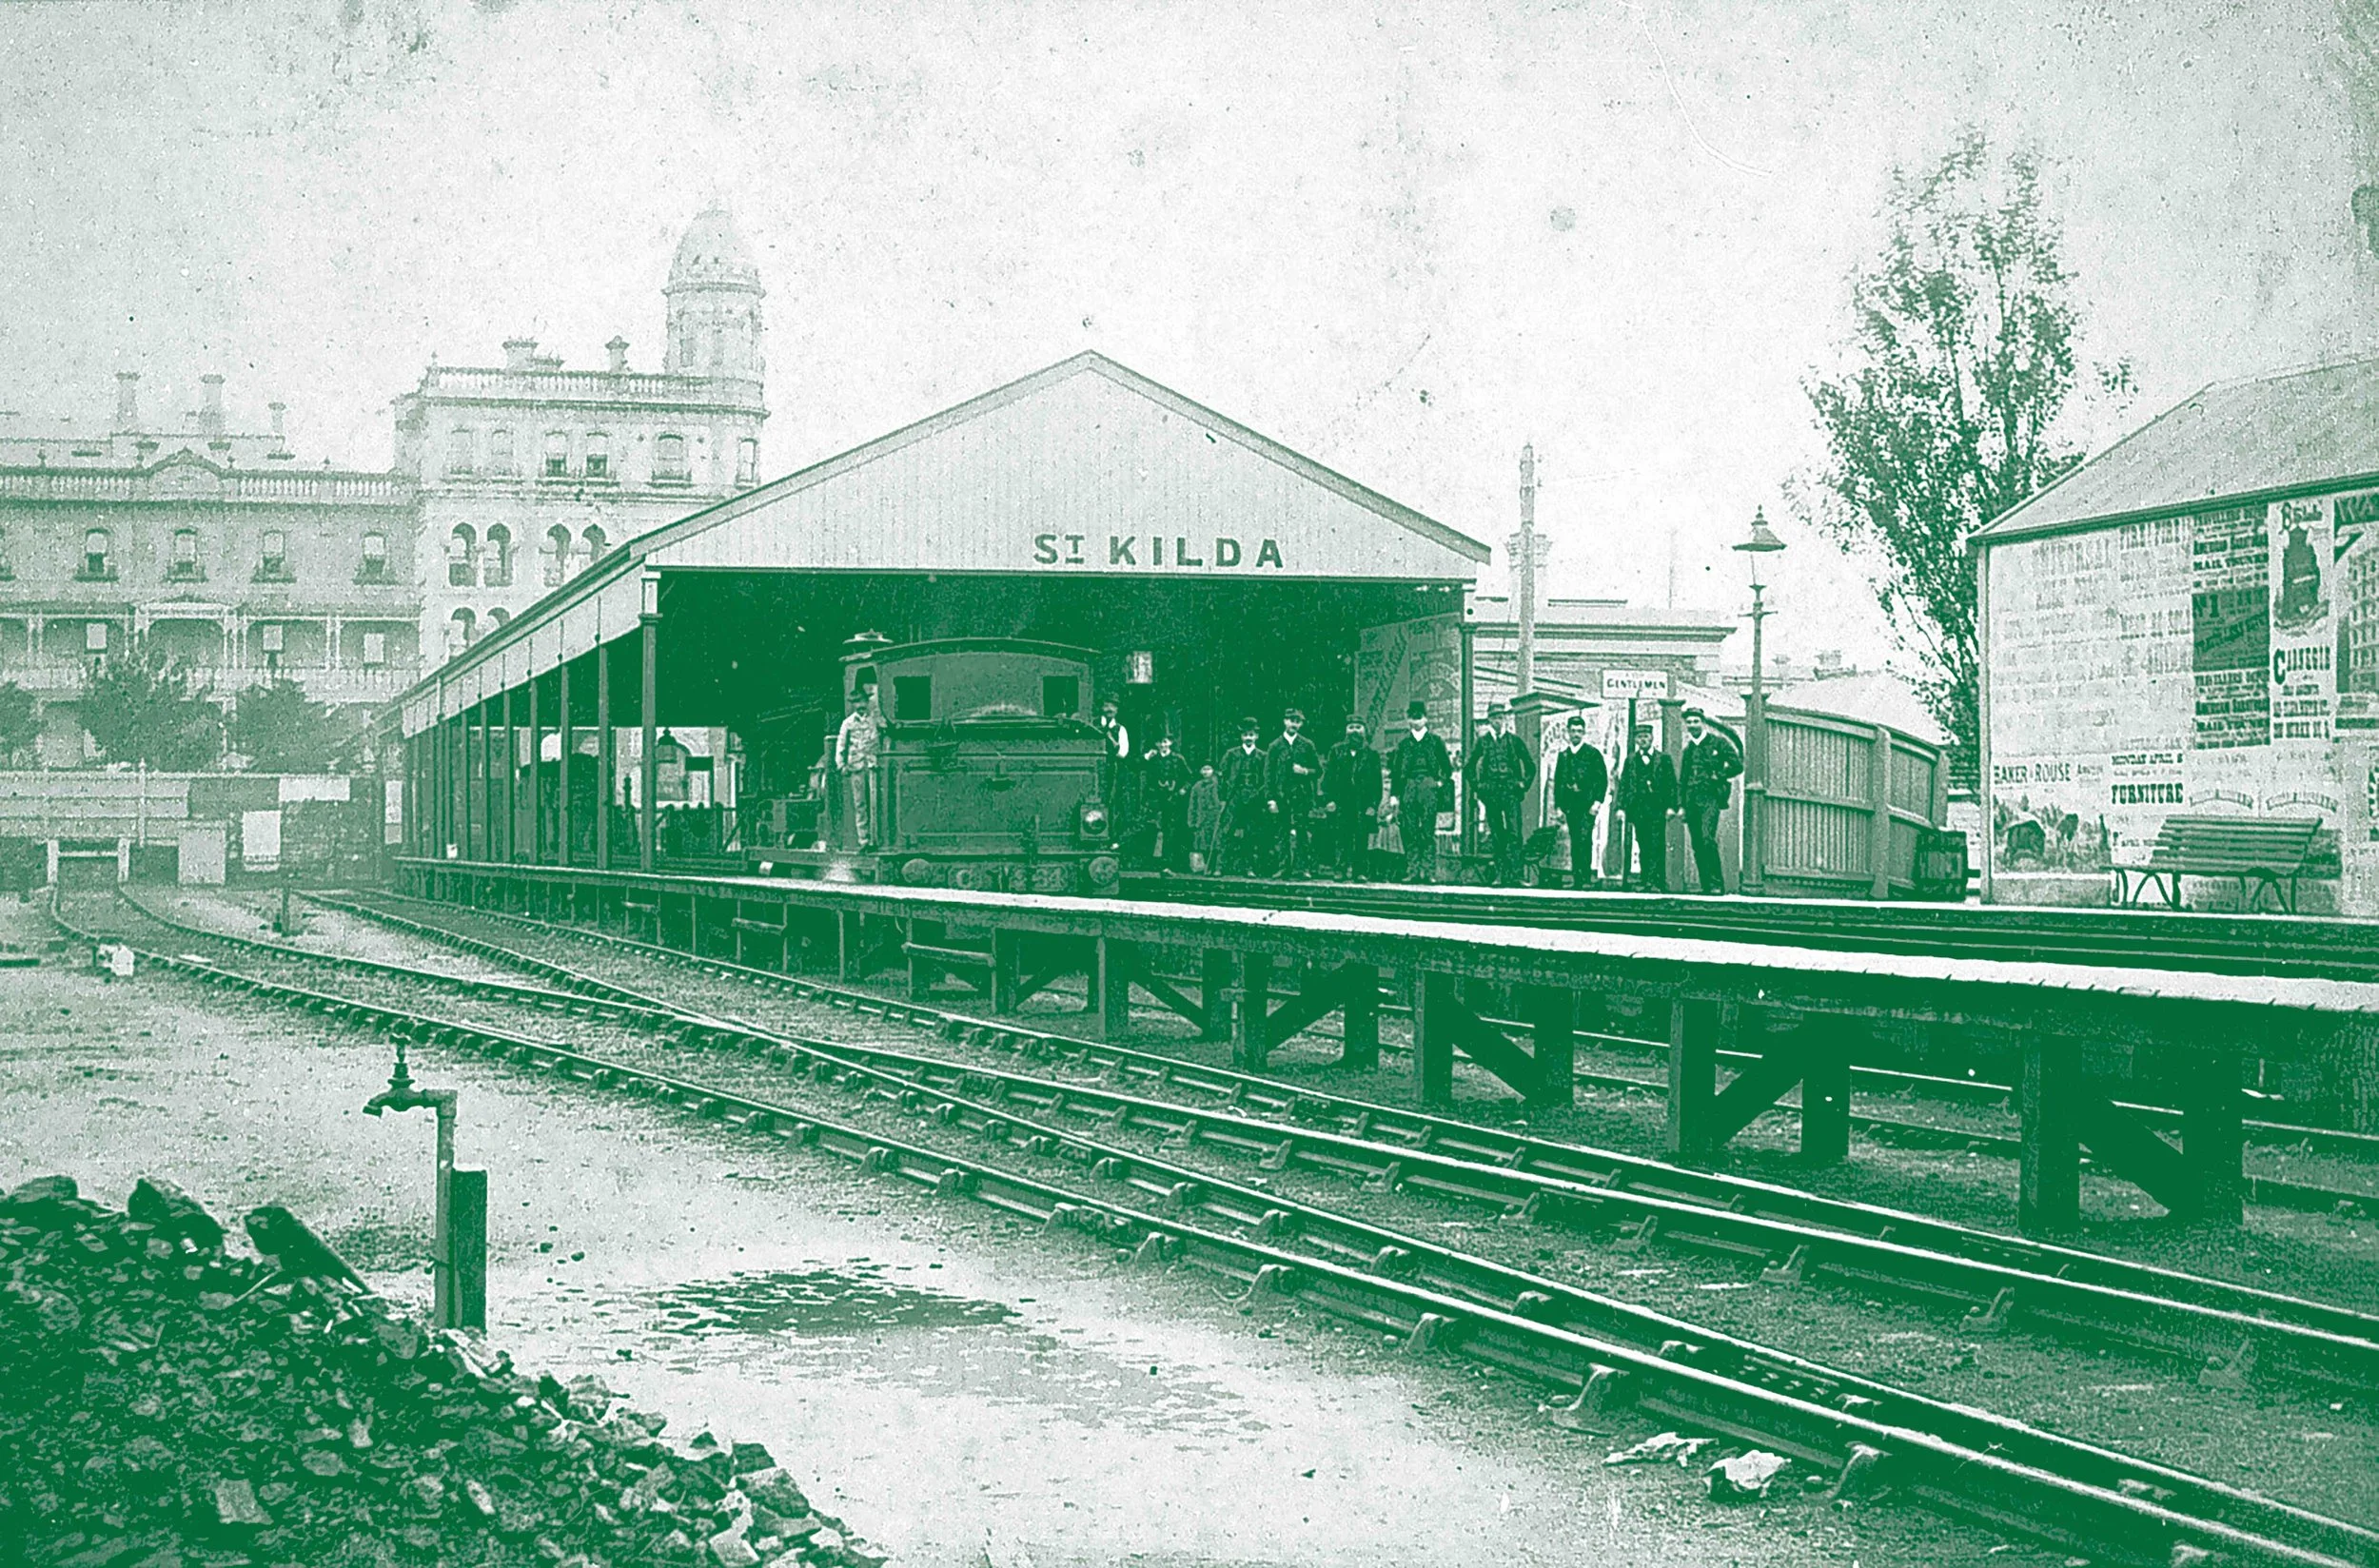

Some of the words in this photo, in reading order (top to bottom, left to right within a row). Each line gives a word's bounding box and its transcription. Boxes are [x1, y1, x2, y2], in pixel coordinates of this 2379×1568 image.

[1108, 535, 1284, 568] KILDA
[1606, 677, 1666, 689] GENTLEMEN
[2112, 782, 2183, 805] FURNITURE
